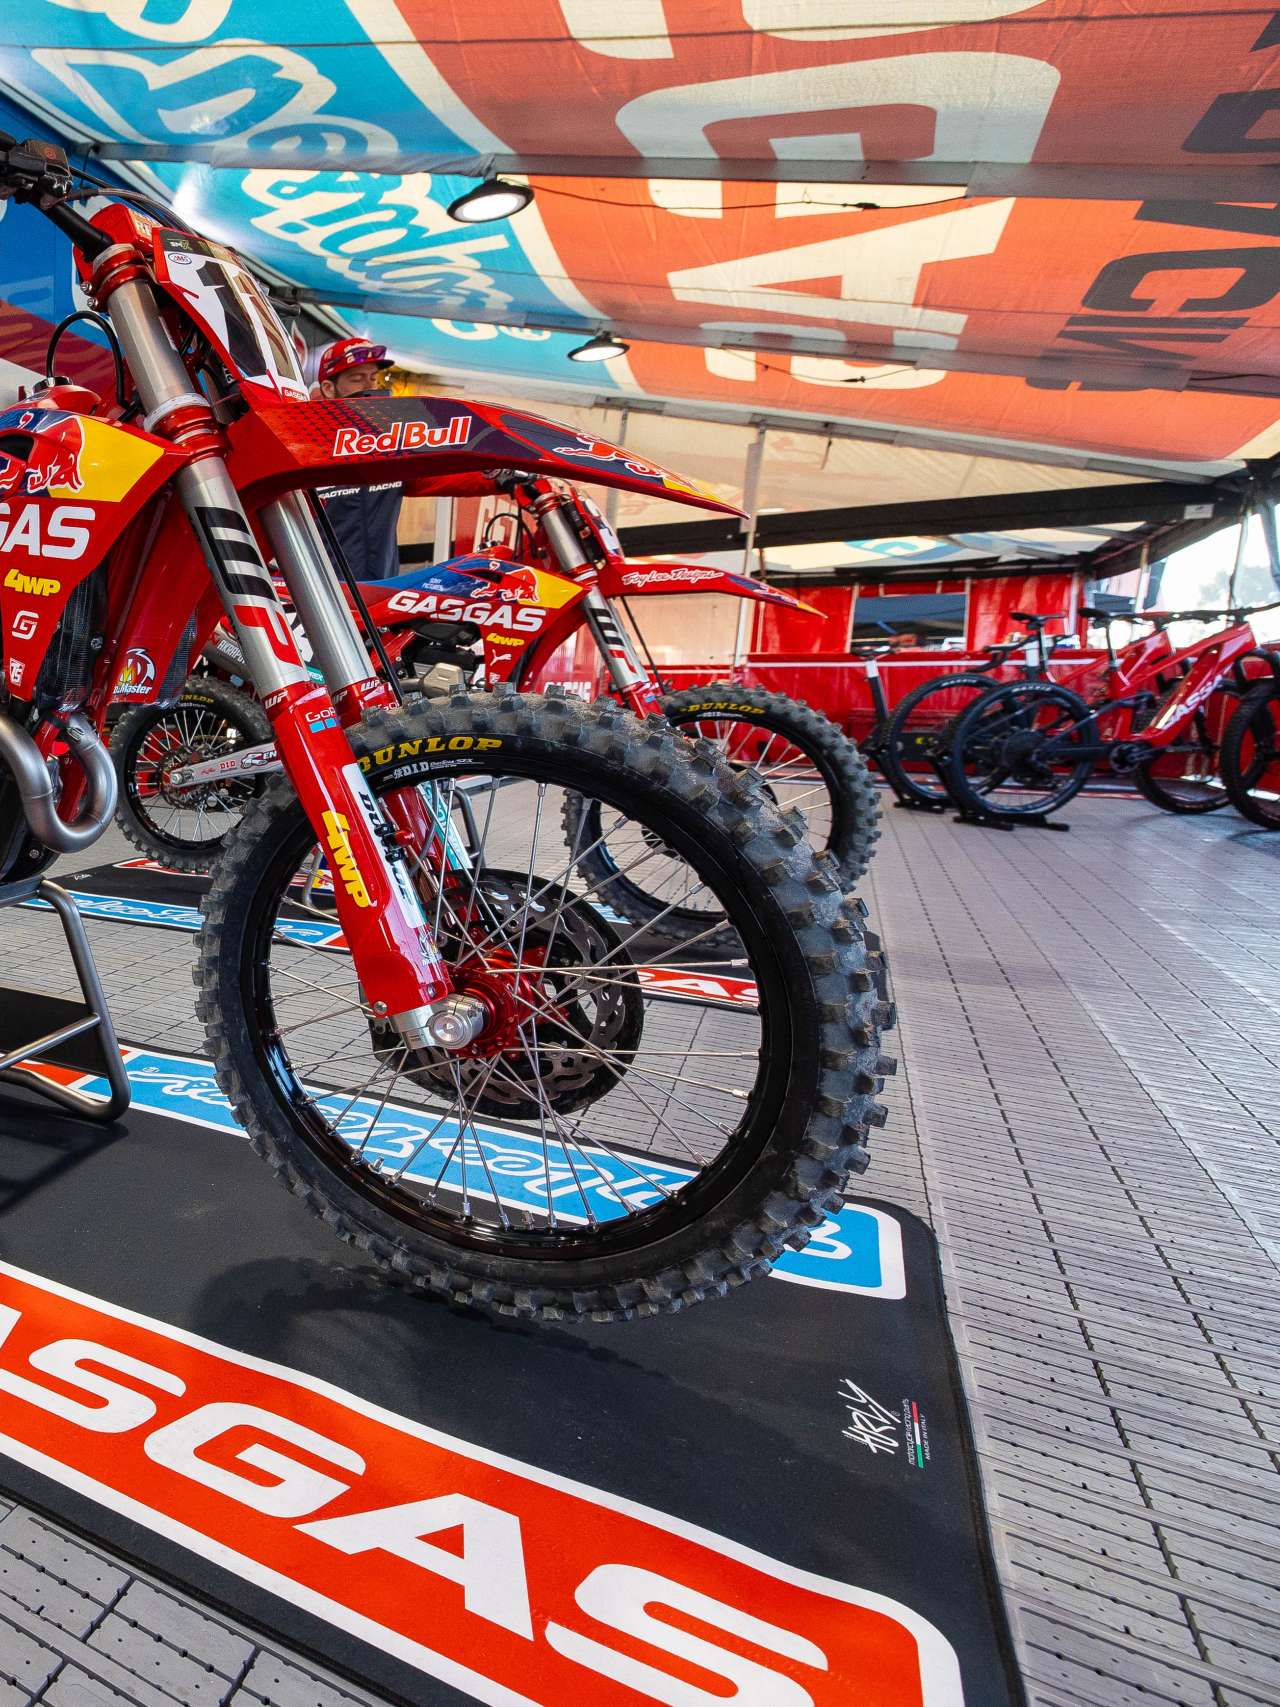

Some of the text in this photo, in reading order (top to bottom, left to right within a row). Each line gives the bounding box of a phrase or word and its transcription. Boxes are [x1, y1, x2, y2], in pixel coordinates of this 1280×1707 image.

[333, 415, 472, 457] Red Bull
[387, 591, 547, 632] GASGAS
[688, 702, 766, 714] DUNLOP
[357, 735, 503, 772] DUNLOP
